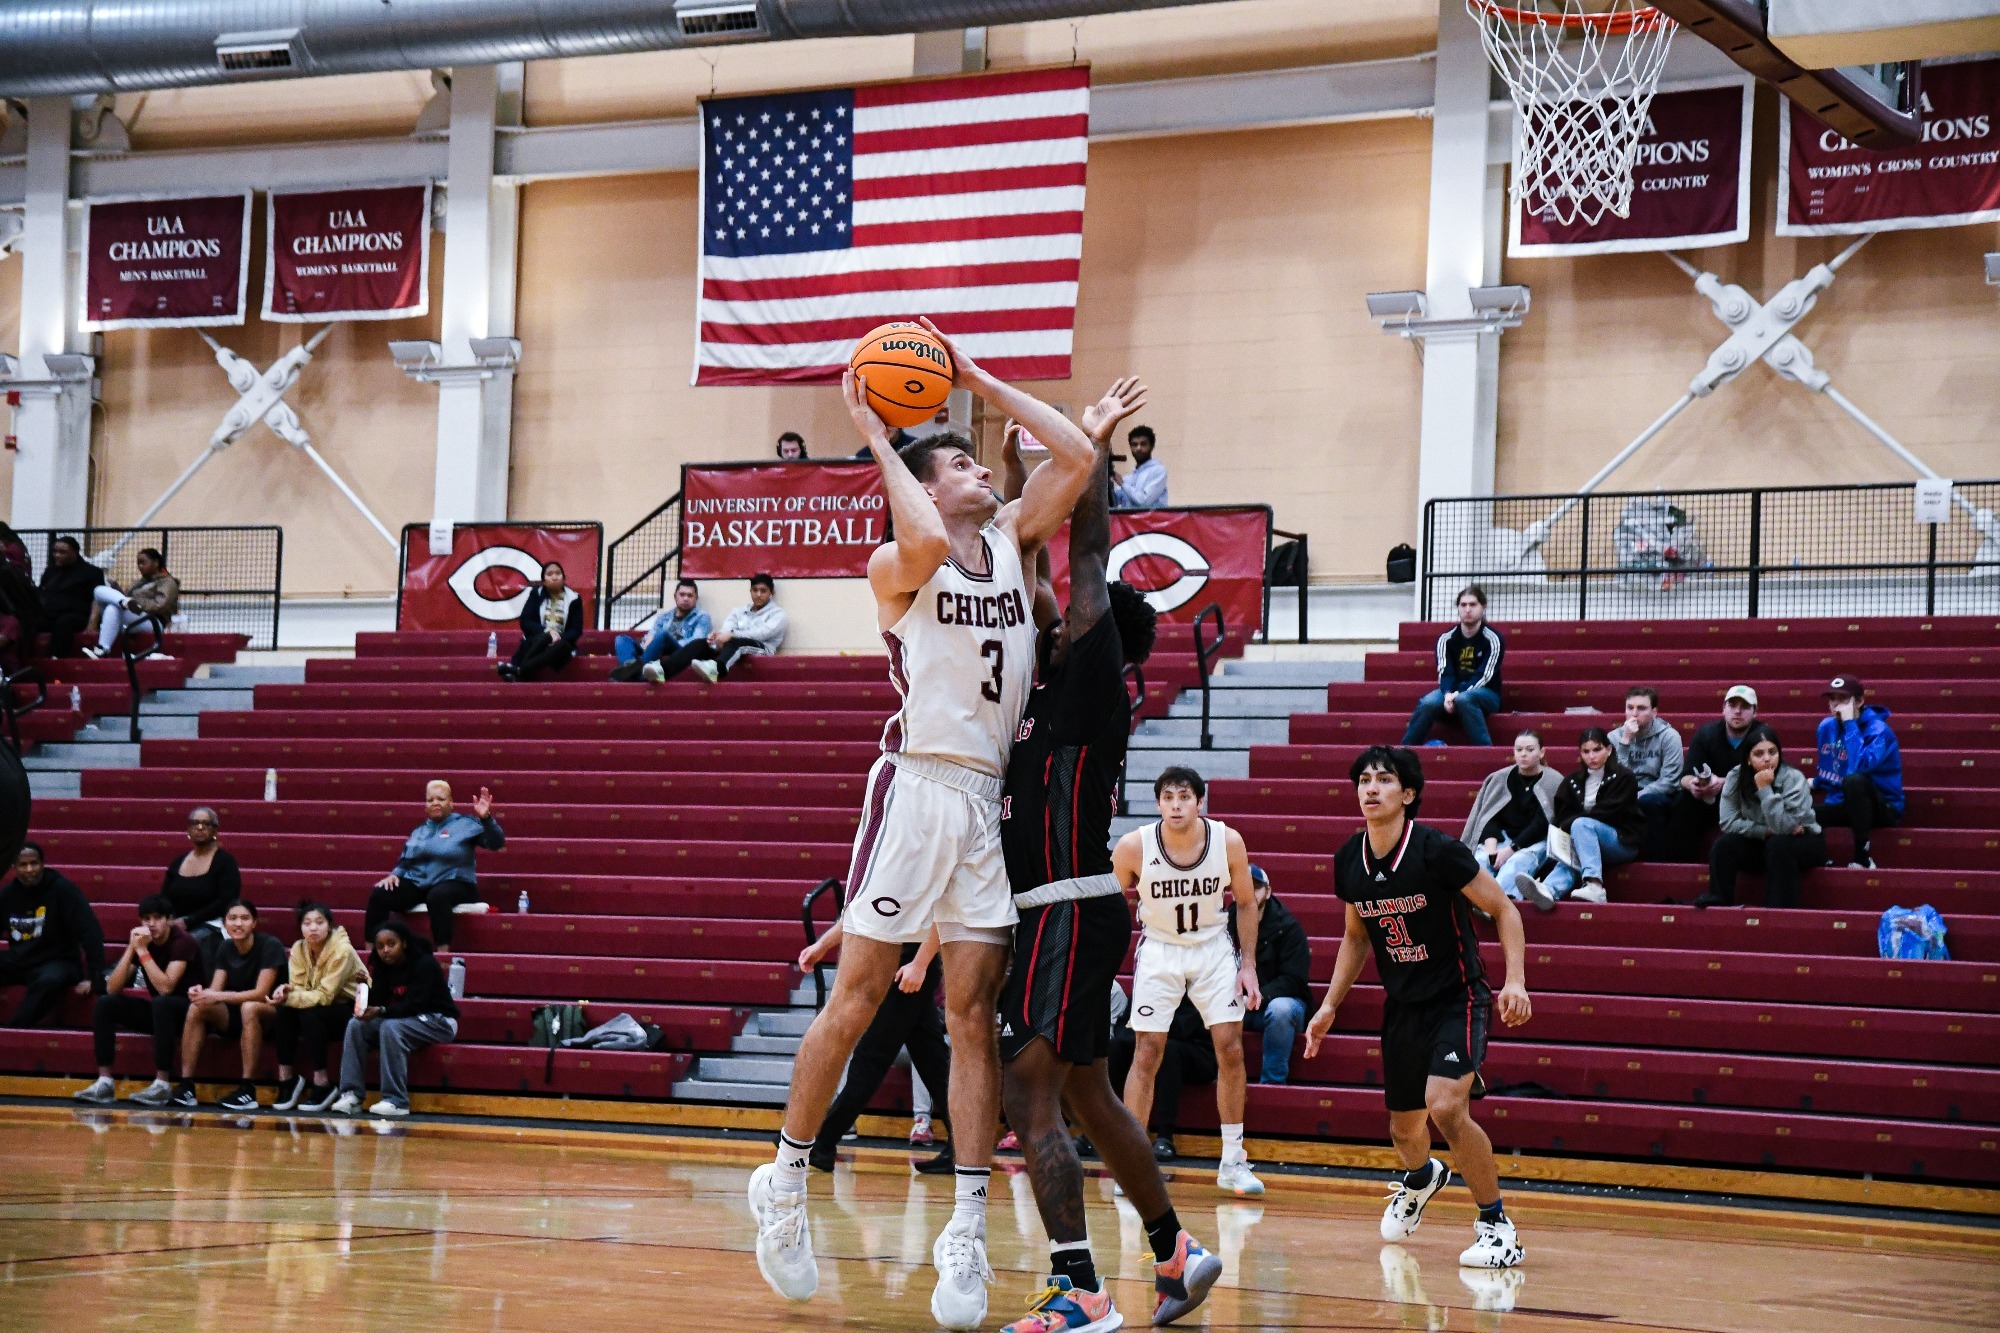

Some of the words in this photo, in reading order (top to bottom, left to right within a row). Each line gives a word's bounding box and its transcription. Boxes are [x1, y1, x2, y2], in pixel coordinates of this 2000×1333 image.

[1819, 115, 1990, 152] CIONS
[1808, 162, 1872, 179] WOMEN'S
[1877, 158, 1922, 173] CROSS
[1928, 150, 2000, 170] COUNTRY
[1641, 174, 1710, 191] COUNTRY
[147, 216, 185, 236] UAA
[329, 209, 368, 229] UAA
[108, 238, 221, 261] CHAMPIONS
[292, 231, 403, 256] CHAMPIONS
[119, 270, 148, 282] MEN'S
[150, 268, 208, 281] BASKETBALL
[295, 264, 338, 277] WOMEN'S
[341, 261, 398, 275] BASKETBALL
[881, 340, 947, 369] Wilson
[686, 497, 781, 514] UNIVERSITY
[784, 496, 806, 512] OF
[809, 495, 884, 512] CHICAGO
[686, 518, 882, 547] BASKETBALL
[980, 639, 1004, 704] 3
[1151, 877, 1220, 899] CHICAGO
[1175, 902, 1199, 935] 11
[1379, 915, 1413, 947] 31
